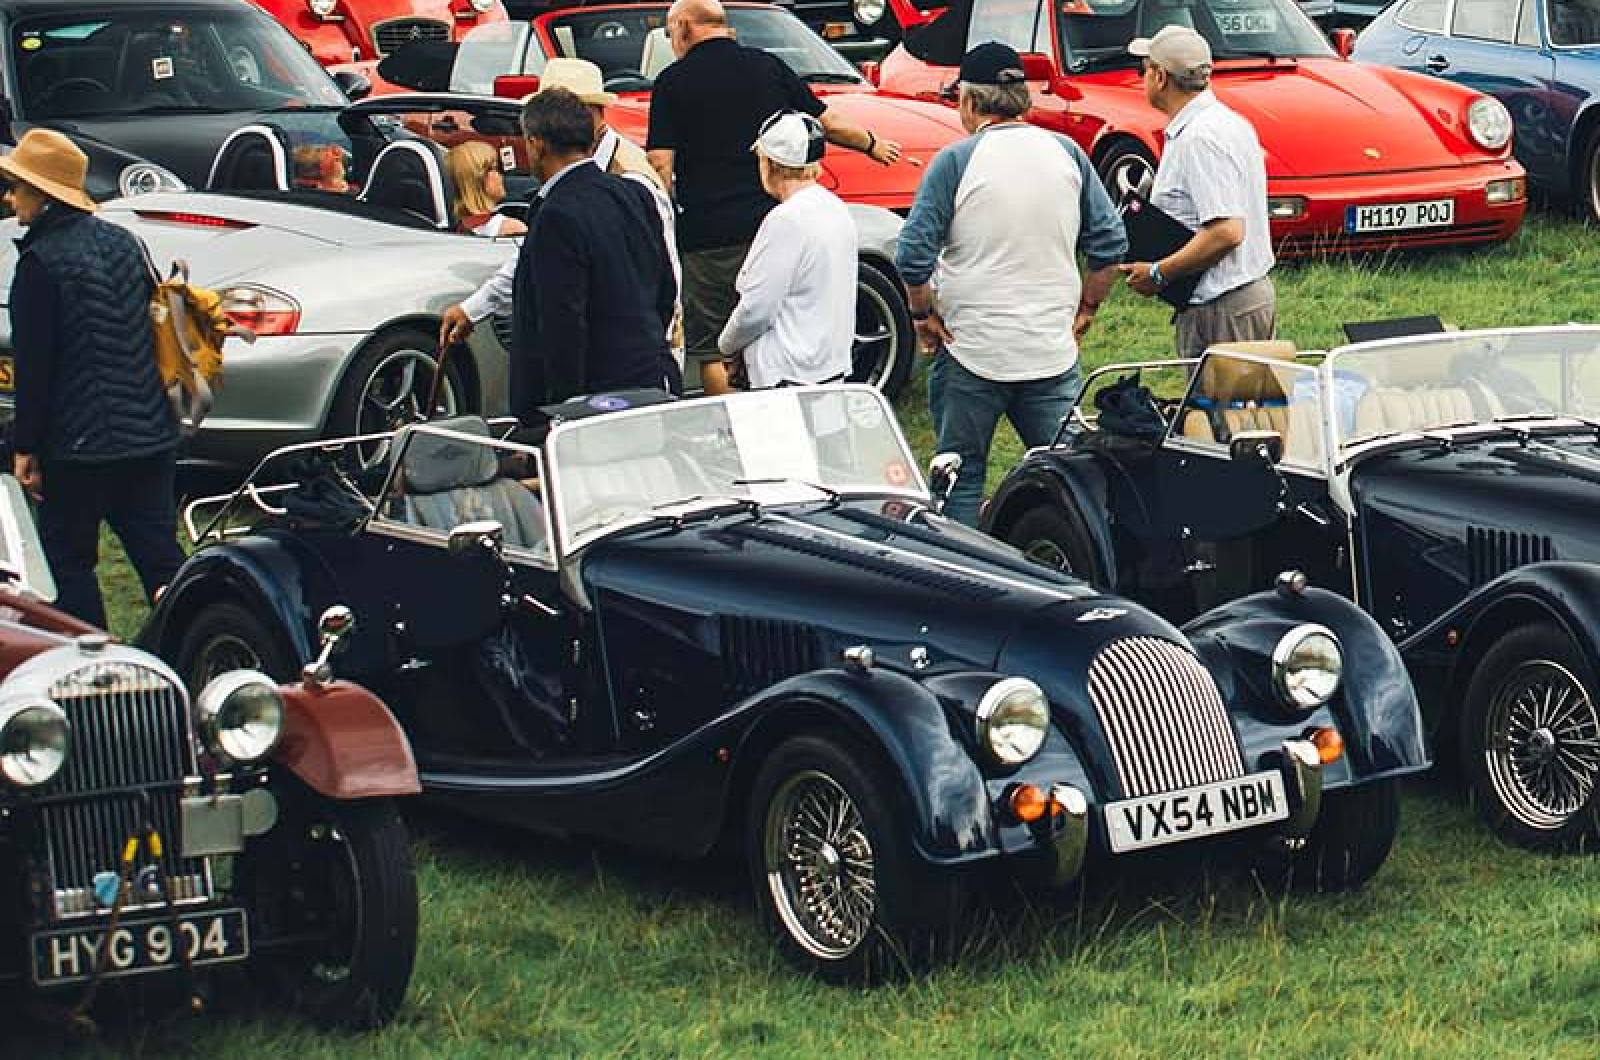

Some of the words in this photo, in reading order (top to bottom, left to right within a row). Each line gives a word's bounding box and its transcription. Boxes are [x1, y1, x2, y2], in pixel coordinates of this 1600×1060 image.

[1361, 206, 1407, 228] H119
[1417, 203, 1451, 224] POJ
[1122, 791, 1214, 841] VX54
[1220, 780, 1277, 823] NBM
[51, 929, 135, 977] HYG
